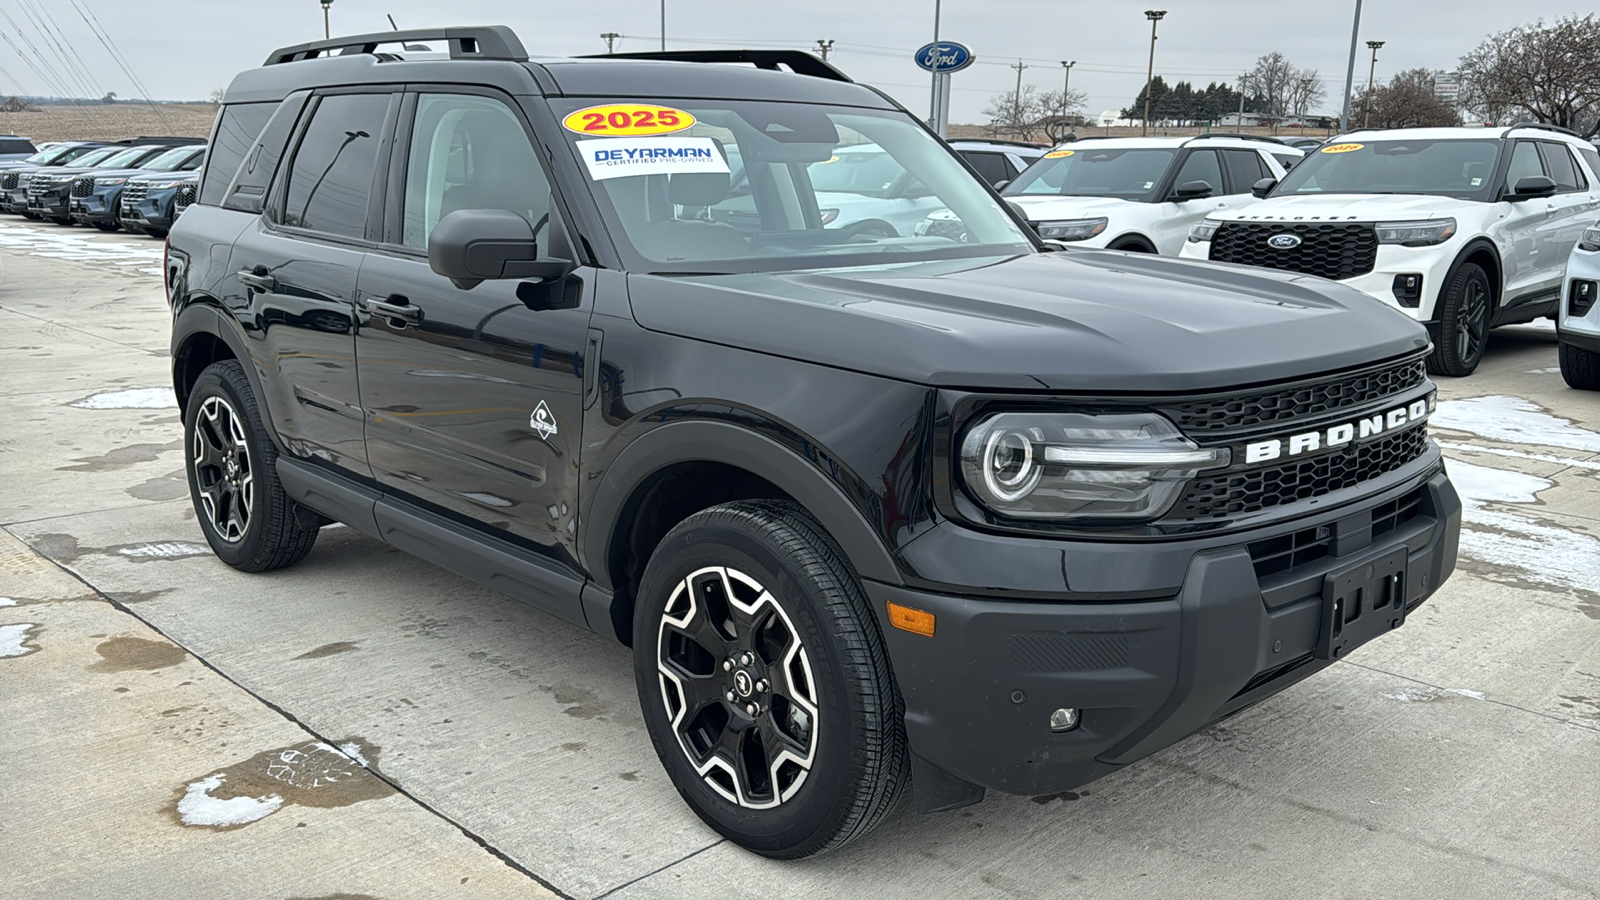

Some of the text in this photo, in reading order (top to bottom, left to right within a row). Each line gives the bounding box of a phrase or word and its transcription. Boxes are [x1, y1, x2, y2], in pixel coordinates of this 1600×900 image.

[924, 47, 959, 66] Ford
[582, 110, 680, 131] 2025
[595, 148, 711, 162] DEYARMAN
[606, 158, 656, 166] CERTIFIED
[1274, 237, 1293, 246] Ford
[1245, 399, 1426, 464] BRONCO
